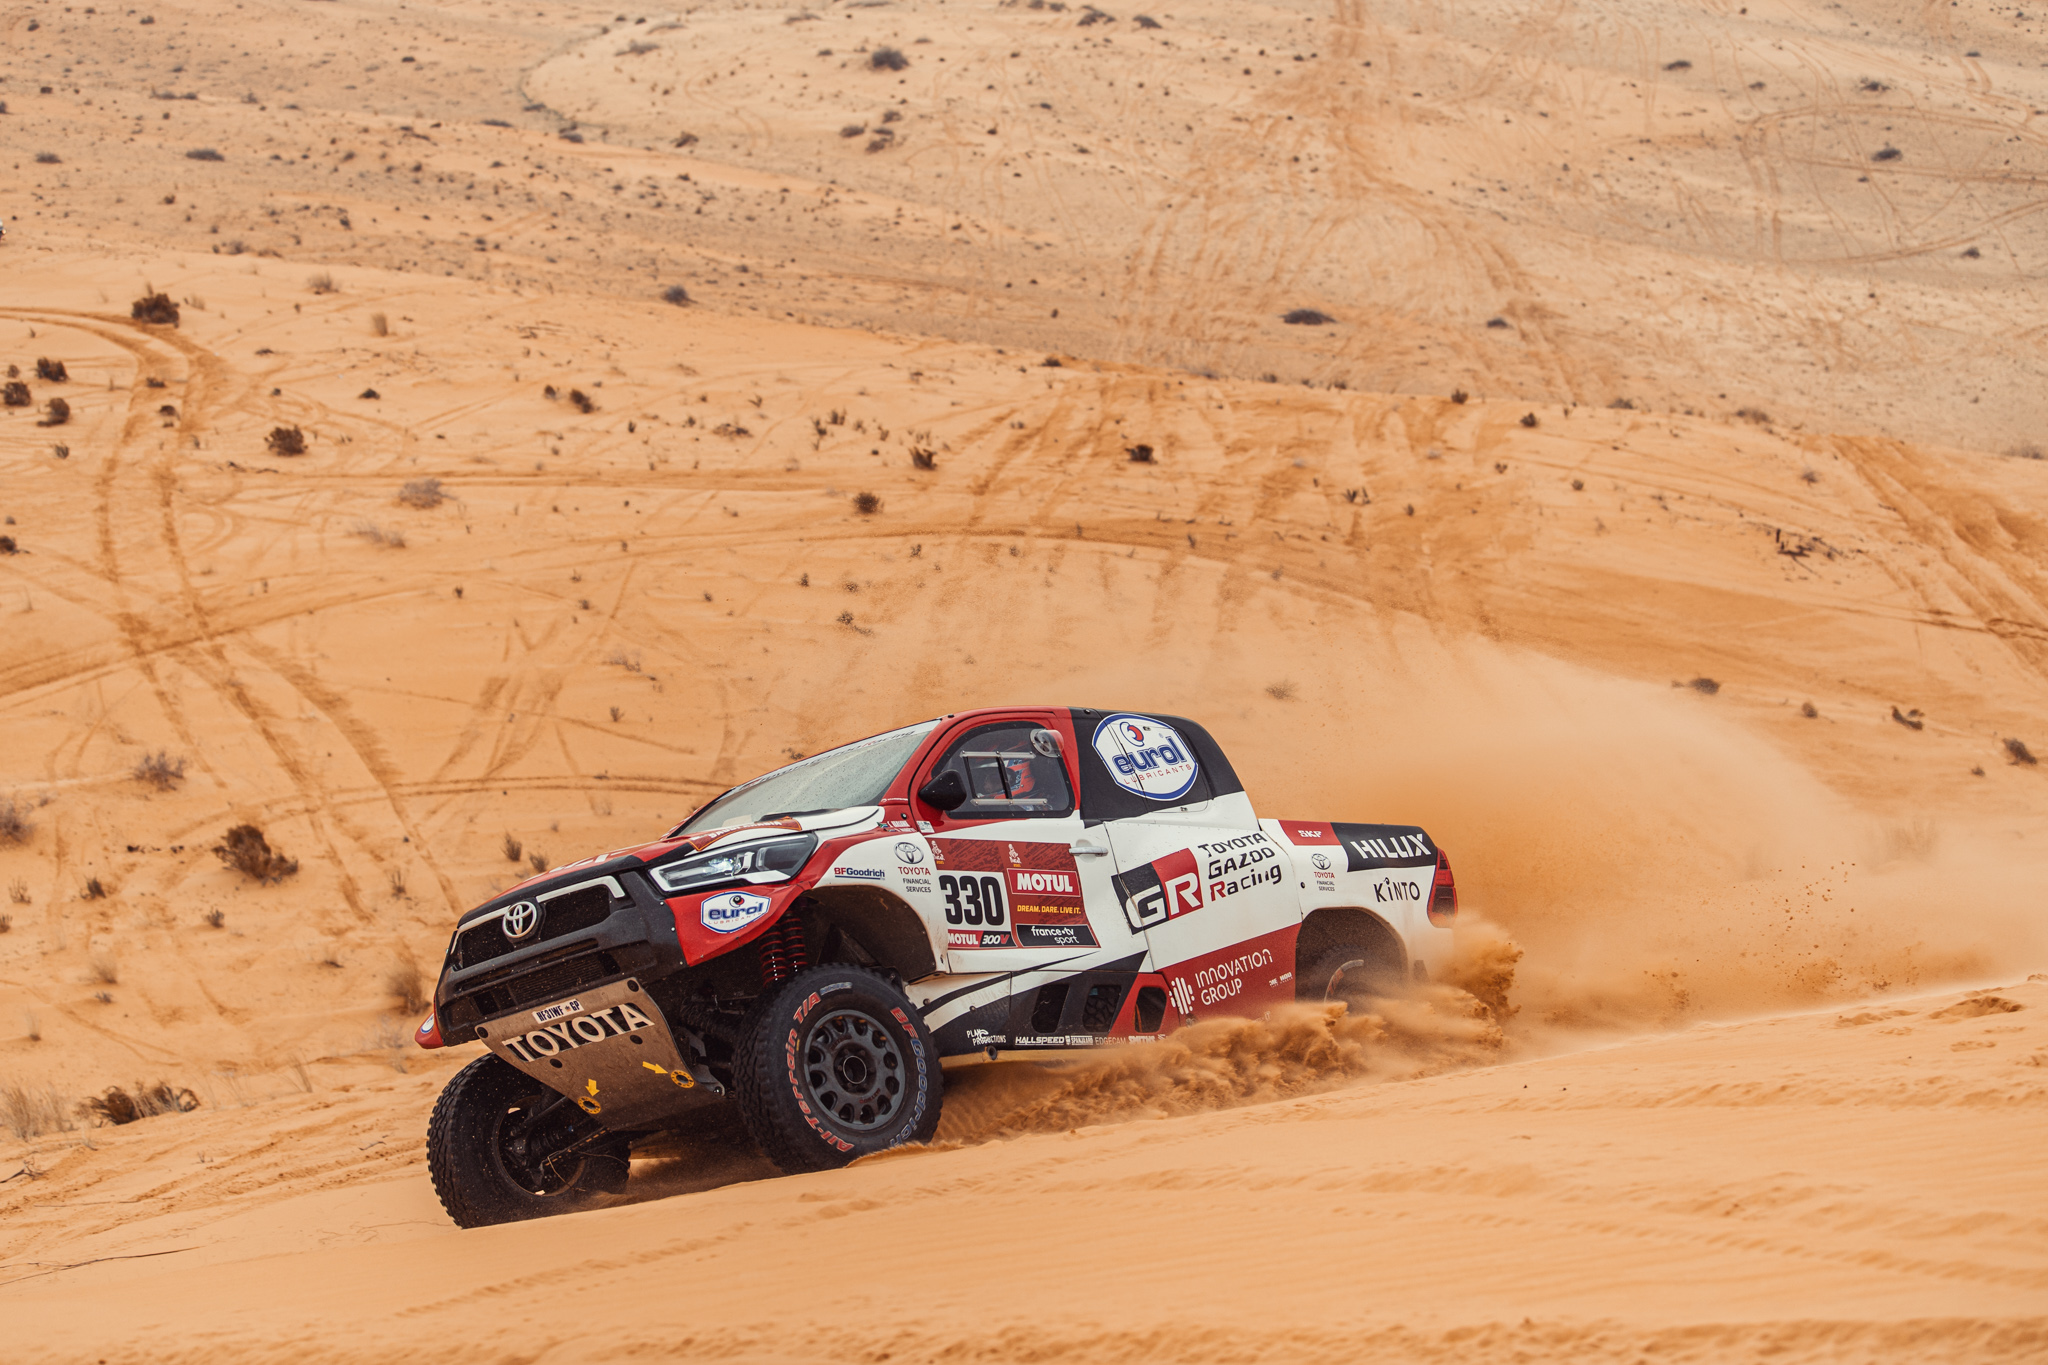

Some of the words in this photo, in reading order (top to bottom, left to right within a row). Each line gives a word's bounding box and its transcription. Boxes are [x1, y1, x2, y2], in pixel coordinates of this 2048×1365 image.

[1112, 736, 1187, 775] eurol
[1123, 764, 1192, 785] LUBRICANTS
[1298, 830, 1322, 838] SKF
[1197, 832, 1267, 858] TOYOTA
[1350, 833, 1431, 859] HILUX
[834, 867, 885, 878] BFGoodrich
[898, 867, 931, 876] TOYOTA
[1208, 847, 1275, 880] GAZOO
[1017, 873, 1073, 893] MOTUL
[1209, 864, 1282, 902] Racing
[939, 875, 1004, 926] 330
[1017, 905, 1040, 913] DREAM.
[1041, 906, 1059, 914] DARE.
[1060, 906, 1073, 914] LIVE
[1125, 872, 1201, 928] GR
[708, 903, 764, 920] eurol
[948, 933, 978, 945] MOTUL
[982, 934, 1010, 945] 300V
[1054, 934, 1079, 946] sport
[1201, 978, 1242, 1006] GROUP
[569, 1000, 580, 1011] GP
[502, 1003, 655, 1062] TOYOTA
[1015, 1036, 1064, 1045] HALLSPEED
[1095, 1036, 1126, 1045] EDGECAM
